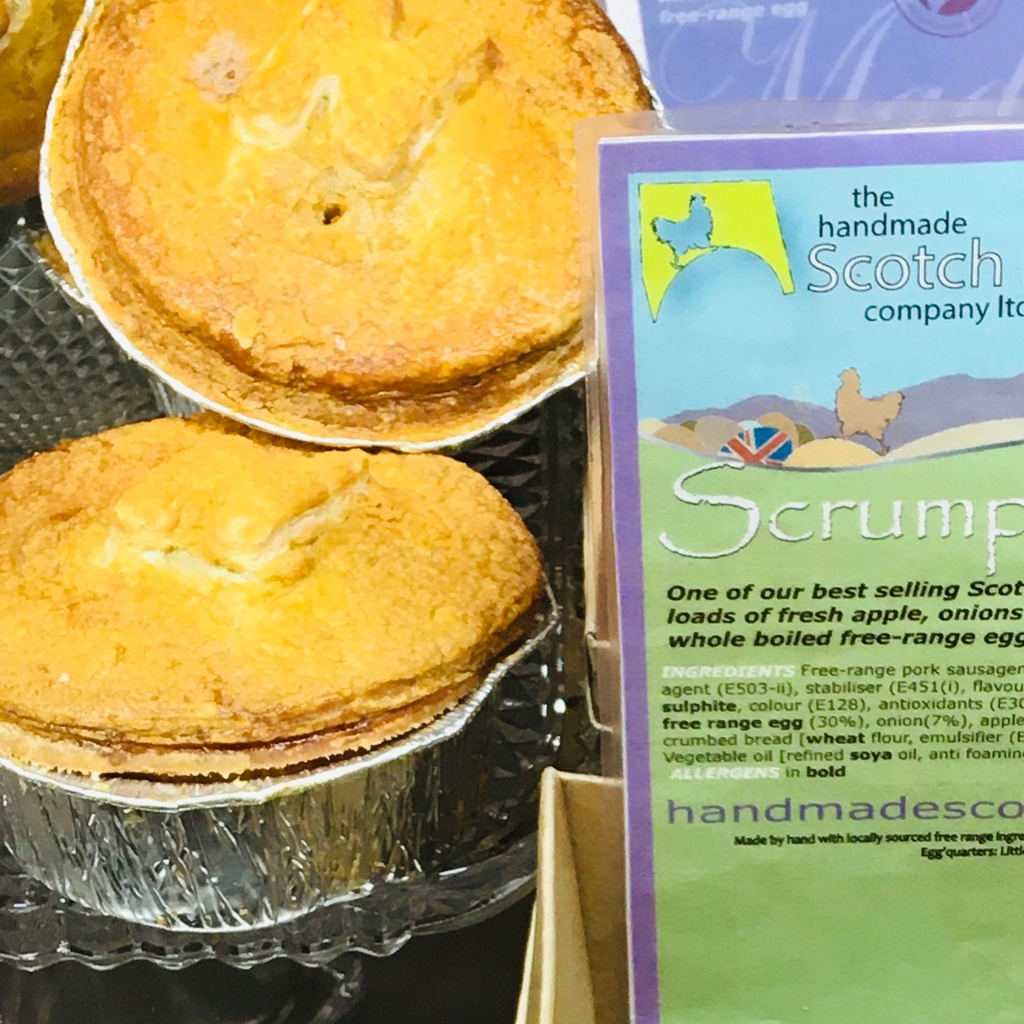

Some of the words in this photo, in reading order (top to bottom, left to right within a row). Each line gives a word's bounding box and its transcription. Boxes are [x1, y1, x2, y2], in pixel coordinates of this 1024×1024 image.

[852, 185, 894, 208] the
[818, 213, 968, 238] handmade
[807, 236, 1004, 295] Scotch
[864, 302, 990, 326] company
[667, 585, 719, 601] One
[726, 583, 755, 600] of
[760, 587, 805, 600] our
[811, 583, 868, 600] best
[874, 581, 960, 600] selling
[667, 608, 736, 624] loads
[744, 607, 774, 624] of
[778, 606, 843, 623] fresh
[851, 605, 928, 625] apple,
[938, 603, 1024, 621] onions
[669, 631, 746, 648] whole
[753, 630, 833, 647] boiled
[840, 629, 976, 649] free-range
[662, 665, 796, 678] INGREDIENTS
[801, 664, 896, 679] Free-range
[902, 664, 940, 678] pork
[661, 683, 711, 698] agent
[805, 678, 883, 694] stabiliser
[662, 717, 702, 730] free
[707, 719, 762, 731] range
[768, 719, 803, 731] egg
[810, 715, 869, 730] (30%),
[876, 714, 973, 729] onion(7%),
[670, 767, 781, 780] ALLERGENS
[786, 769, 800, 778] in
[806, 765, 846, 778] bold
